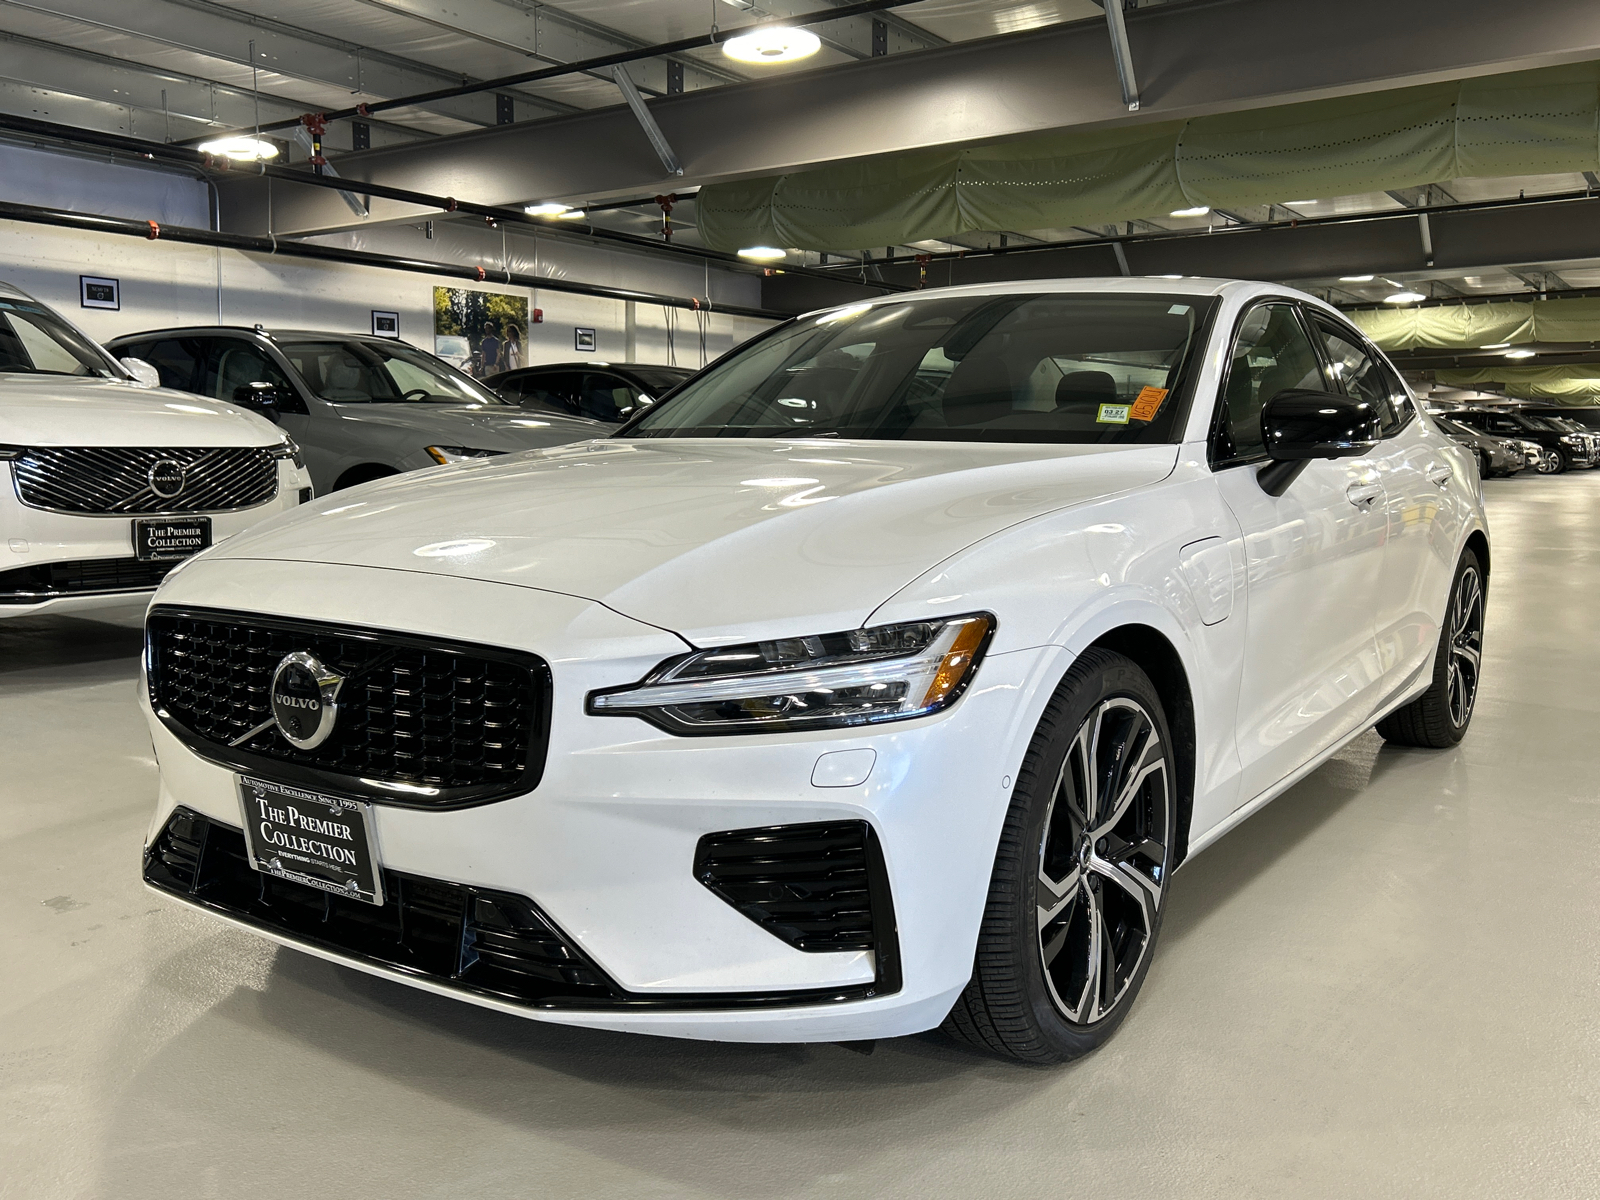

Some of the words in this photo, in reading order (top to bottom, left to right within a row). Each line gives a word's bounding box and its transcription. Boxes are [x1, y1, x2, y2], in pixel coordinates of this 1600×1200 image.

[147, 527, 166, 537] THE
[166, 526, 201, 537] PREMIER
[147, 536, 202, 548] COLLECTION
[275, 693, 320, 711] VOLVO
[242, 776, 280, 792] AUTOMOTIVE
[280, 785, 318, 801] EXCELLENCE
[317, 795, 337, 806] SINCE
[338, 799, 357, 810] 1995
[255, 797, 287, 826] THE
[286, 805, 353, 841] PREMIER
[260, 821, 357, 866] COLLECTION
[277, 850, 310, 863] EVERYTHING
